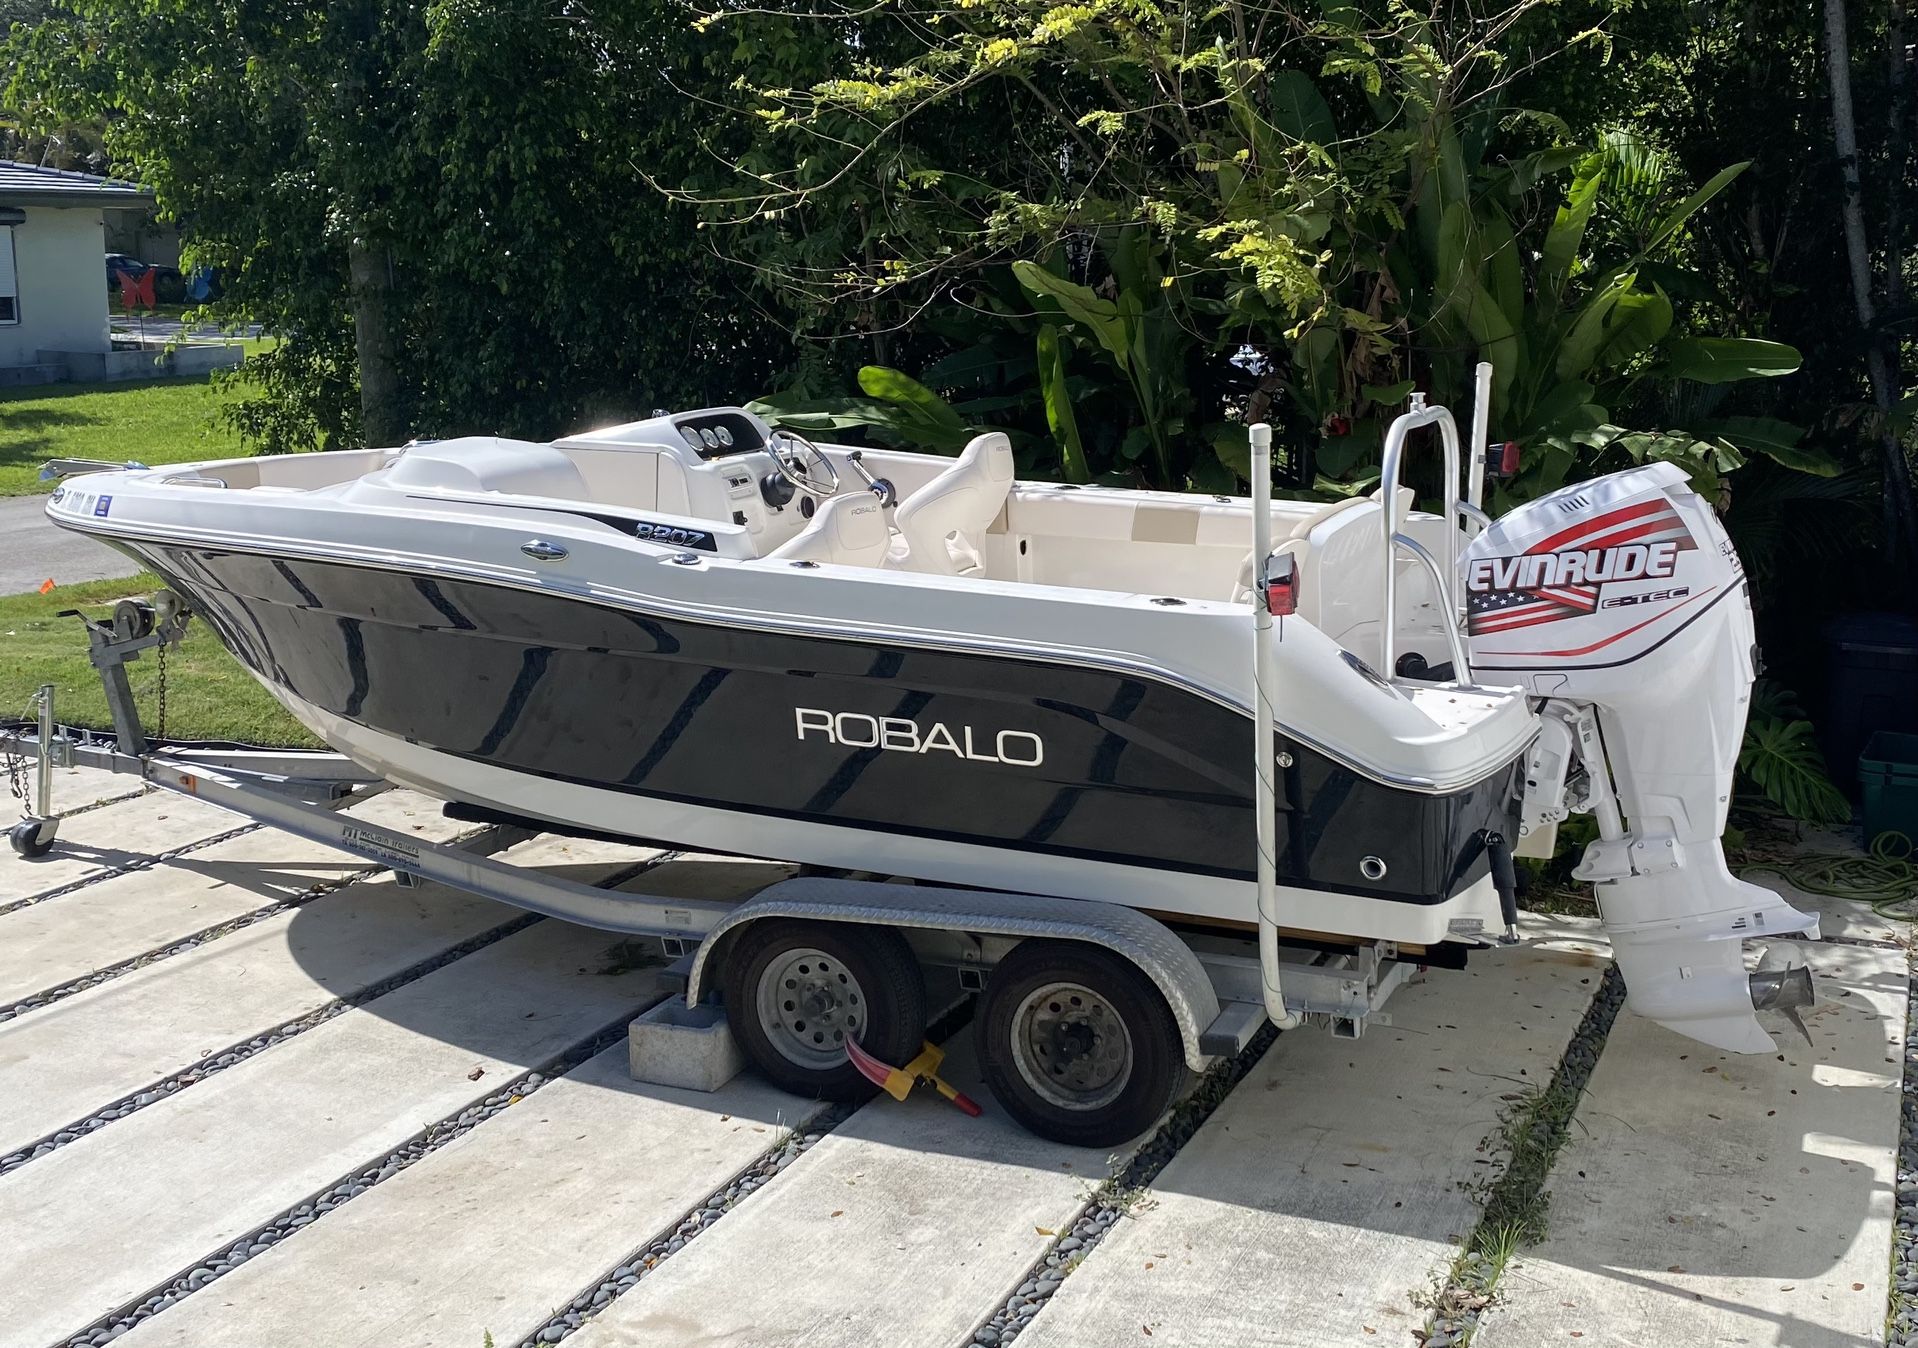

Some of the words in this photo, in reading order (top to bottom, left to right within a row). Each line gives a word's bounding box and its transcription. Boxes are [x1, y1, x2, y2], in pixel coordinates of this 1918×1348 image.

[635, 523, 705, 547] R207
[1468, 542, 1677, 592] EVINRUDE
[1602, 587, 1689, 609] E-TEC
[795, 707, 1043, 767] ROBALO
